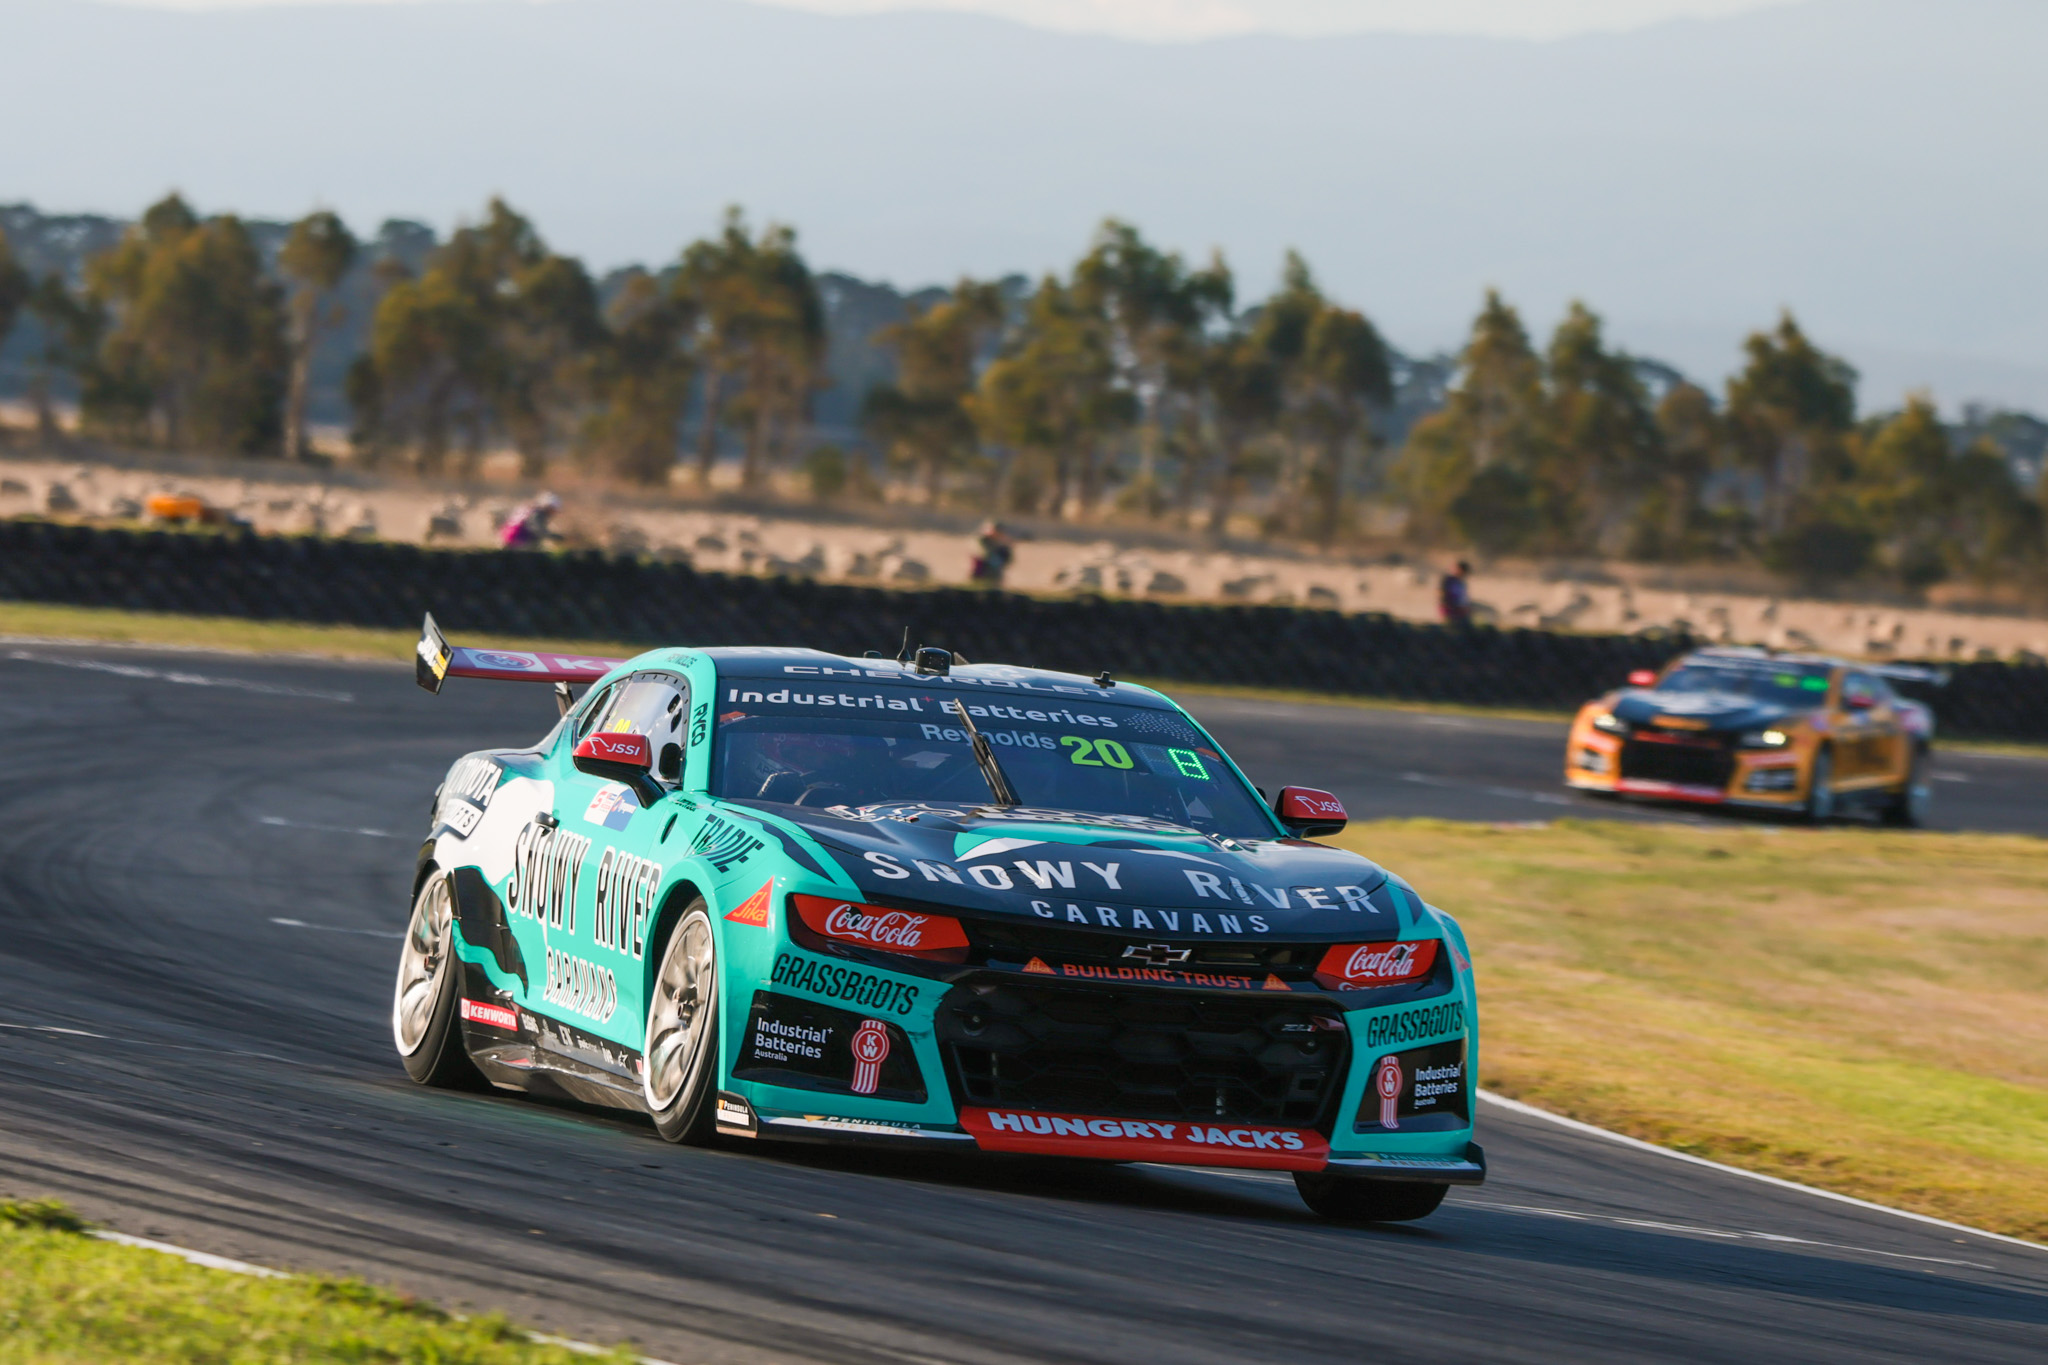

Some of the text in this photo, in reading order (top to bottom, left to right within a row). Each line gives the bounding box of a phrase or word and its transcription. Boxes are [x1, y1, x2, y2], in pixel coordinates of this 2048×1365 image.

[784, 665, 1115, 698] CHEVROLET
[691, 702, 709, 747] RYCO
[939, 701, 1119, 728] Batteries
[606, 743, 641, 756] JSSI
[920, 724, 1134, 770] Reynolds 20
[688, 813, 765, 874] TRADIE
[506, 821, 592, 936] SNOWY
[863, 851, 1381, 914] SNOWY RIVER
[733, 892, 768, 922] Sika
[1031, 900, 1270, 934] CARAVANS
[825, 904, 928, 948] Coca-Cola
[1062, 962, 1252, 988] BUILDING TRUST
[1344, 943, 1420, 979] Coca-Cola
[543, 945, 618, 1024] CARAVANS
[470, 1005, 517, 1028] KENWORTH
[754, 1048, 788, 1062] Australia
[755, 1033, 822, 1059] Batteries
[1414, 1081, 1458, 1098] Batteries
[827, 1115, 921, 1129] PENINSULA
[987, 1111, 1304, 1150] HUNGRY JACK'S
